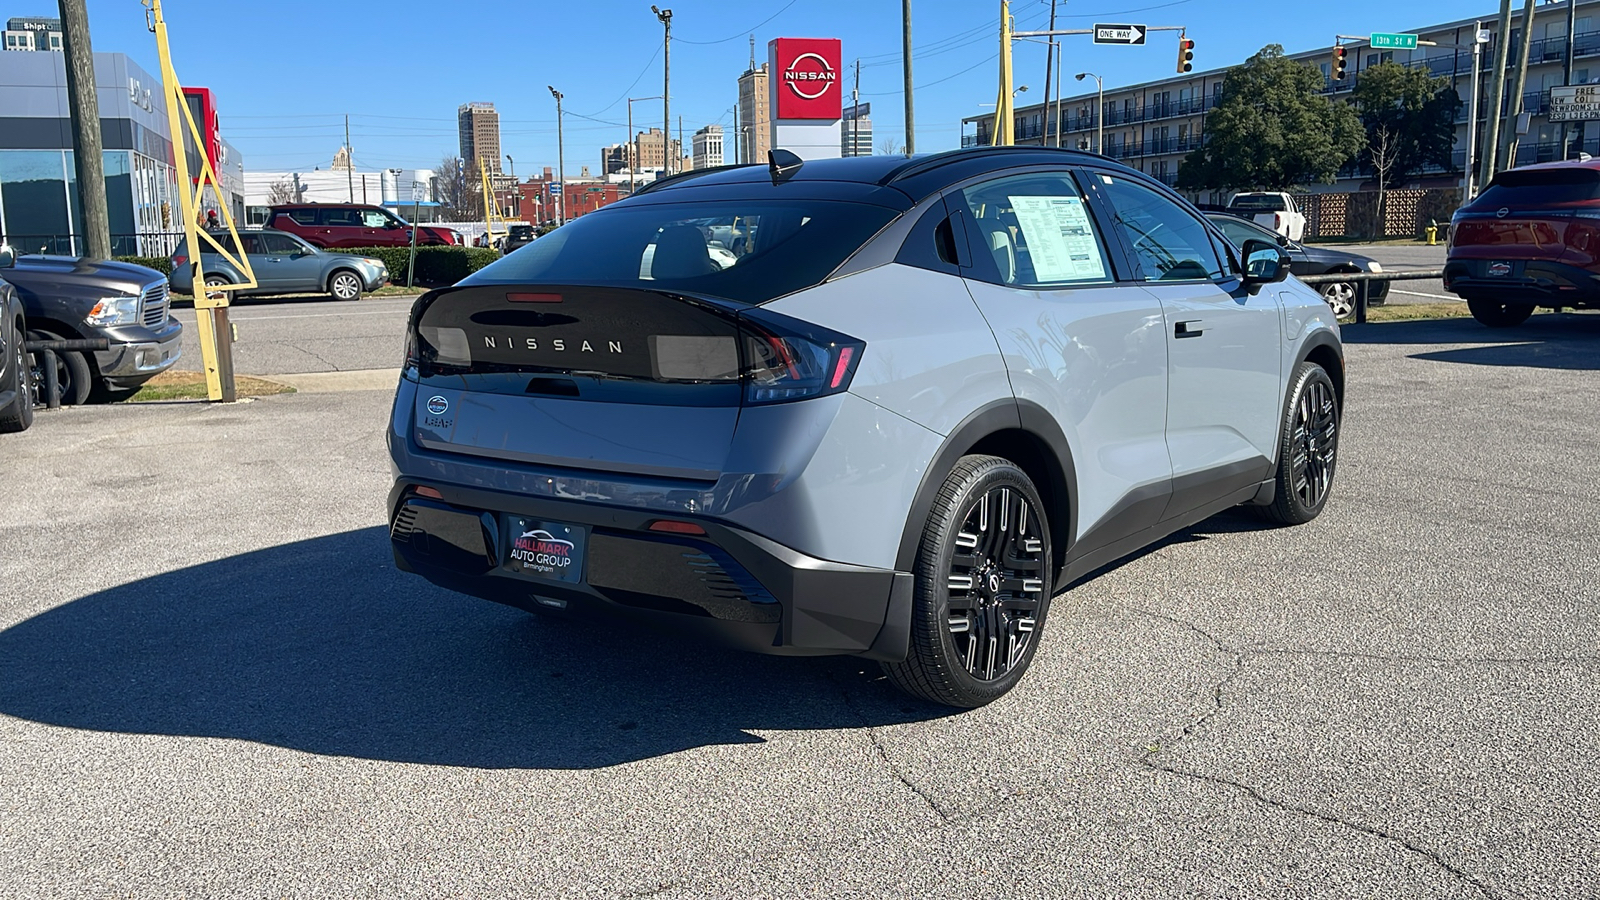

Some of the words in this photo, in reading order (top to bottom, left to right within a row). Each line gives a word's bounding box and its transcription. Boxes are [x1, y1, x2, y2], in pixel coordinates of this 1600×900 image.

[23, 22, 46, 32] Shipt
[1099, 30, 1114, 38] ONE
[1116, 30, 1132, 38] WAY
[1376, 36, 1390, 45] 13th
[1395, 36, 1403, 46] St
[1407, 37, 1413, 46] N
[785, 71, 836, 80] NISSAN
[1575, 87, 1595, 96] FREE
[484, 336, 623, 354] NISSAN
[514, 537, 570, 557] HALLMARK
[510, 548, 535, 562] AUTO
[535, 553, 571, 568] GROUP
[523, 561, 554, 573] Birmingham
